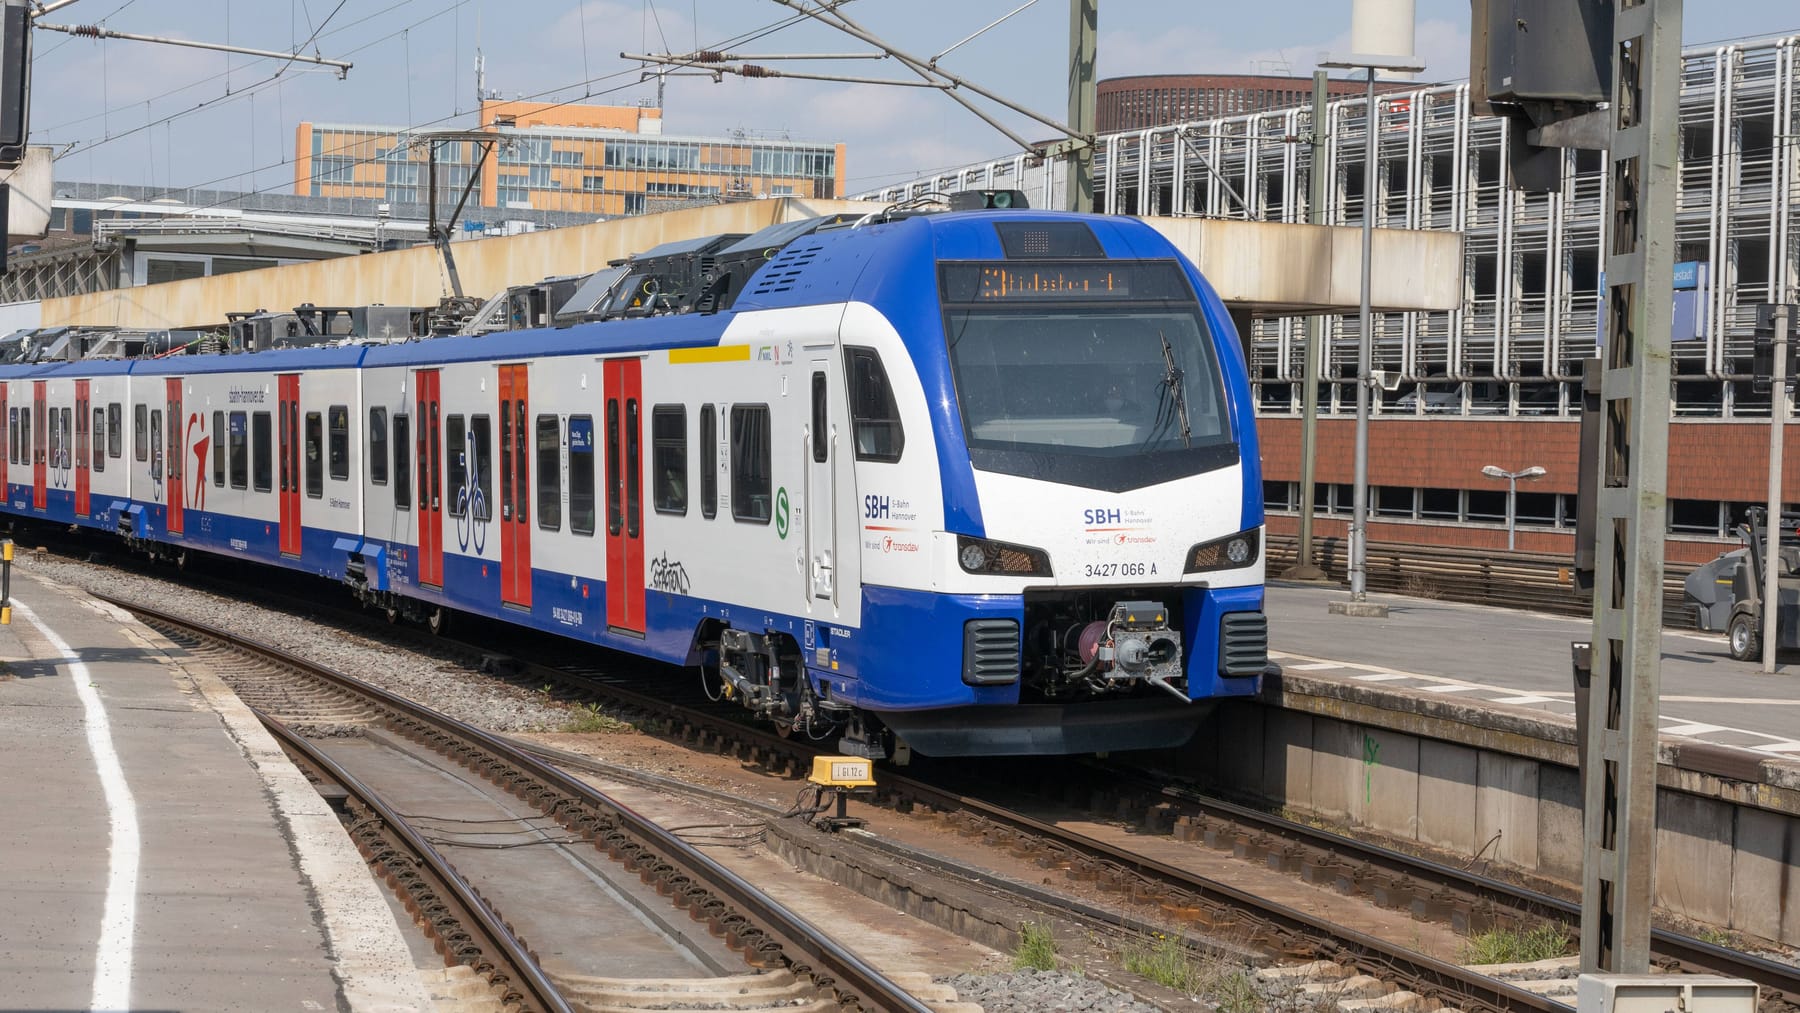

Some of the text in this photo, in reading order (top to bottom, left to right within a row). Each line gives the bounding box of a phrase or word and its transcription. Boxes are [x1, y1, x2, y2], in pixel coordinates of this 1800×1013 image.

[864, 494, 890, 519] SBH
[1084, 508, 1121, 525] SBH
[1084, 561, 1158, 577] 3427 066 A
